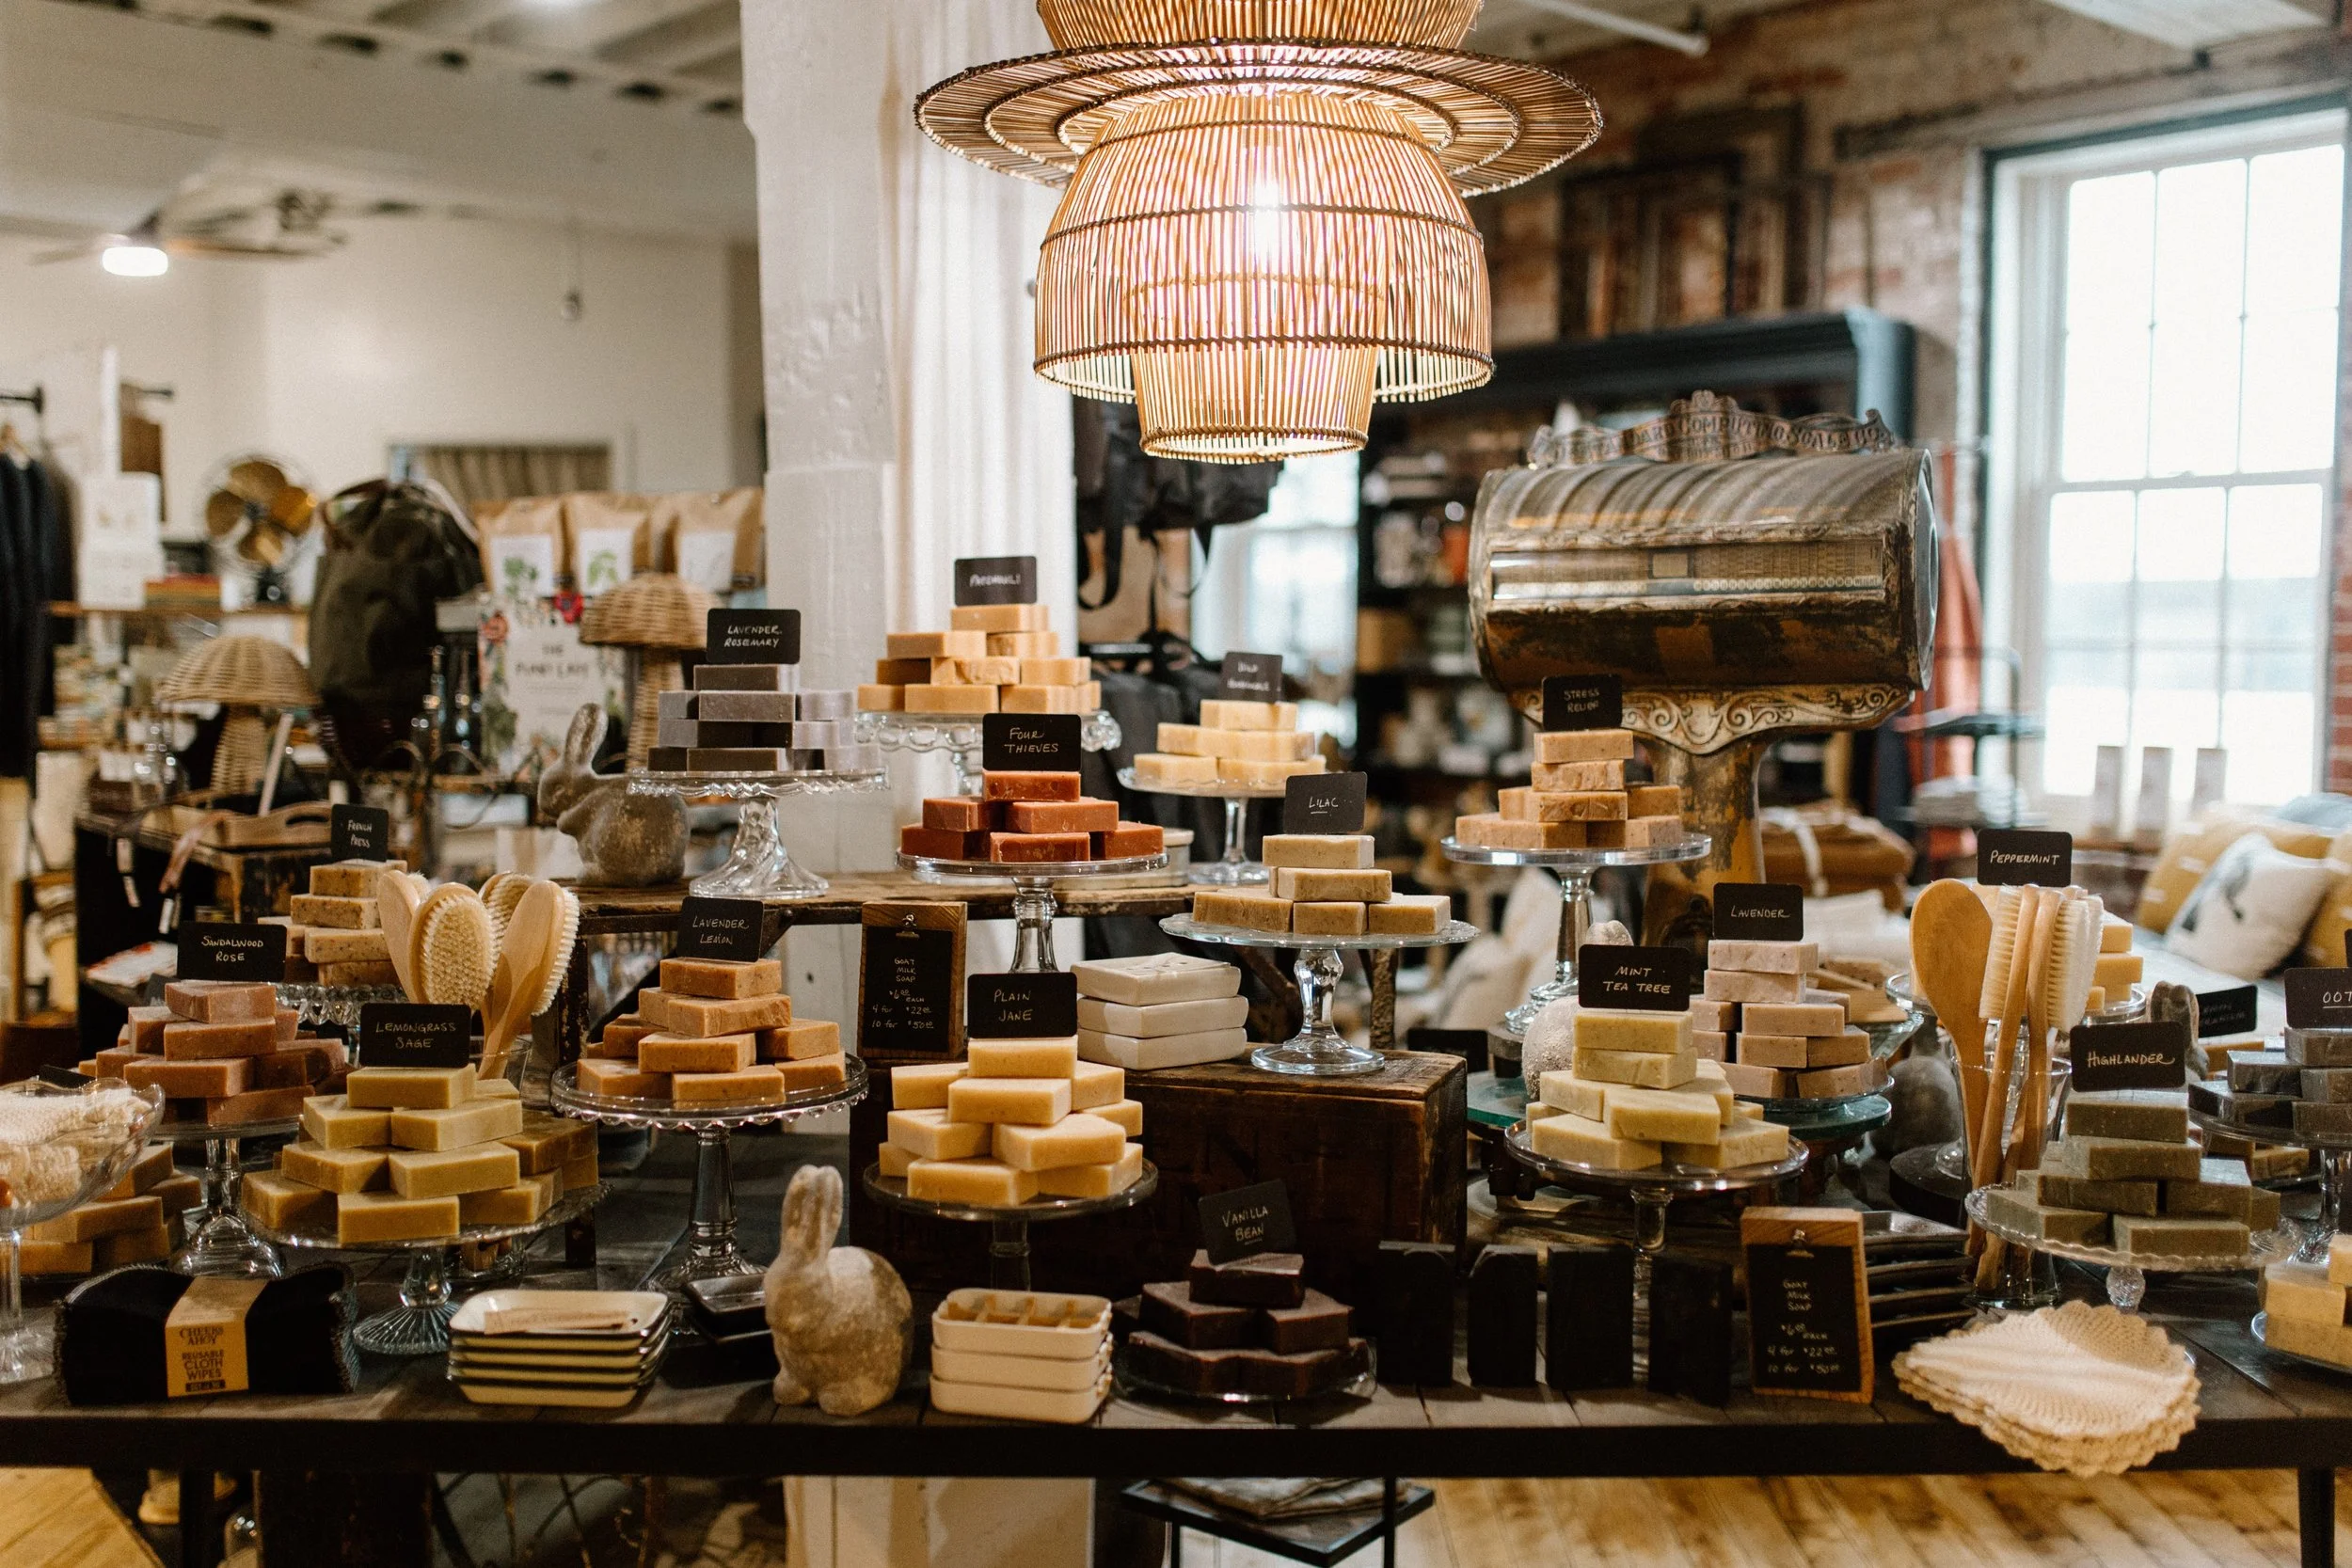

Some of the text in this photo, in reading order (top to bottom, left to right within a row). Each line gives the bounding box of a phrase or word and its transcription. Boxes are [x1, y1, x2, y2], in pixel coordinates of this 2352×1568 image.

[727, 625, 783, 635] LAVENDER
[723, 637, 780, 648] ROSEMARY
[1564, 688, 1600, 701] STRESS
[1004, 743, 1059, 753] THIEVES
[1309, 796, 1339, 809] LILAC
[347, 819, 373, 832] FRENCH
[350, 833, 371, 848] PRESS
[1990, 849, 2060, 865] PEPPERMINT
[1730, 905, 1791, 919] LAVENDER
[692, 916, 750, 930] LAVENDER
[201, 935, 264, 948] SANDALWOOD
[699, 934, 734, 945] LEMON
[215, 951, 246, 962] ROSE
[894, 957, 915, 966] GOAT
[896, 967, 917, 975] MILK
[1614, 966, 1652, 978] MINT
[1602, 980, 1672, 995] TEA TREE
[993, 989, 1032, 1004] PLAIN
[871, 1004, 879, 1014] 4
[998, 1009, 1034, 1022] JANE
[375, 1021, 457, 1034] LEMONGRASS
[871, 1020, 882, 1028] 10
[395, 1037, 434, 1049] SAGE
[2087, 1051, 2176, 1069] HIGHLANDER
[1222, 1206, 1269, 1227] VANILLA
[1235, 1222, 1264, 1242] BEAN
[1788, 1302, 1813, 1311] SOAP
[184, 1358, 223, 1370] CLOTH
[186, 1369, 222, 1381] WIPES
